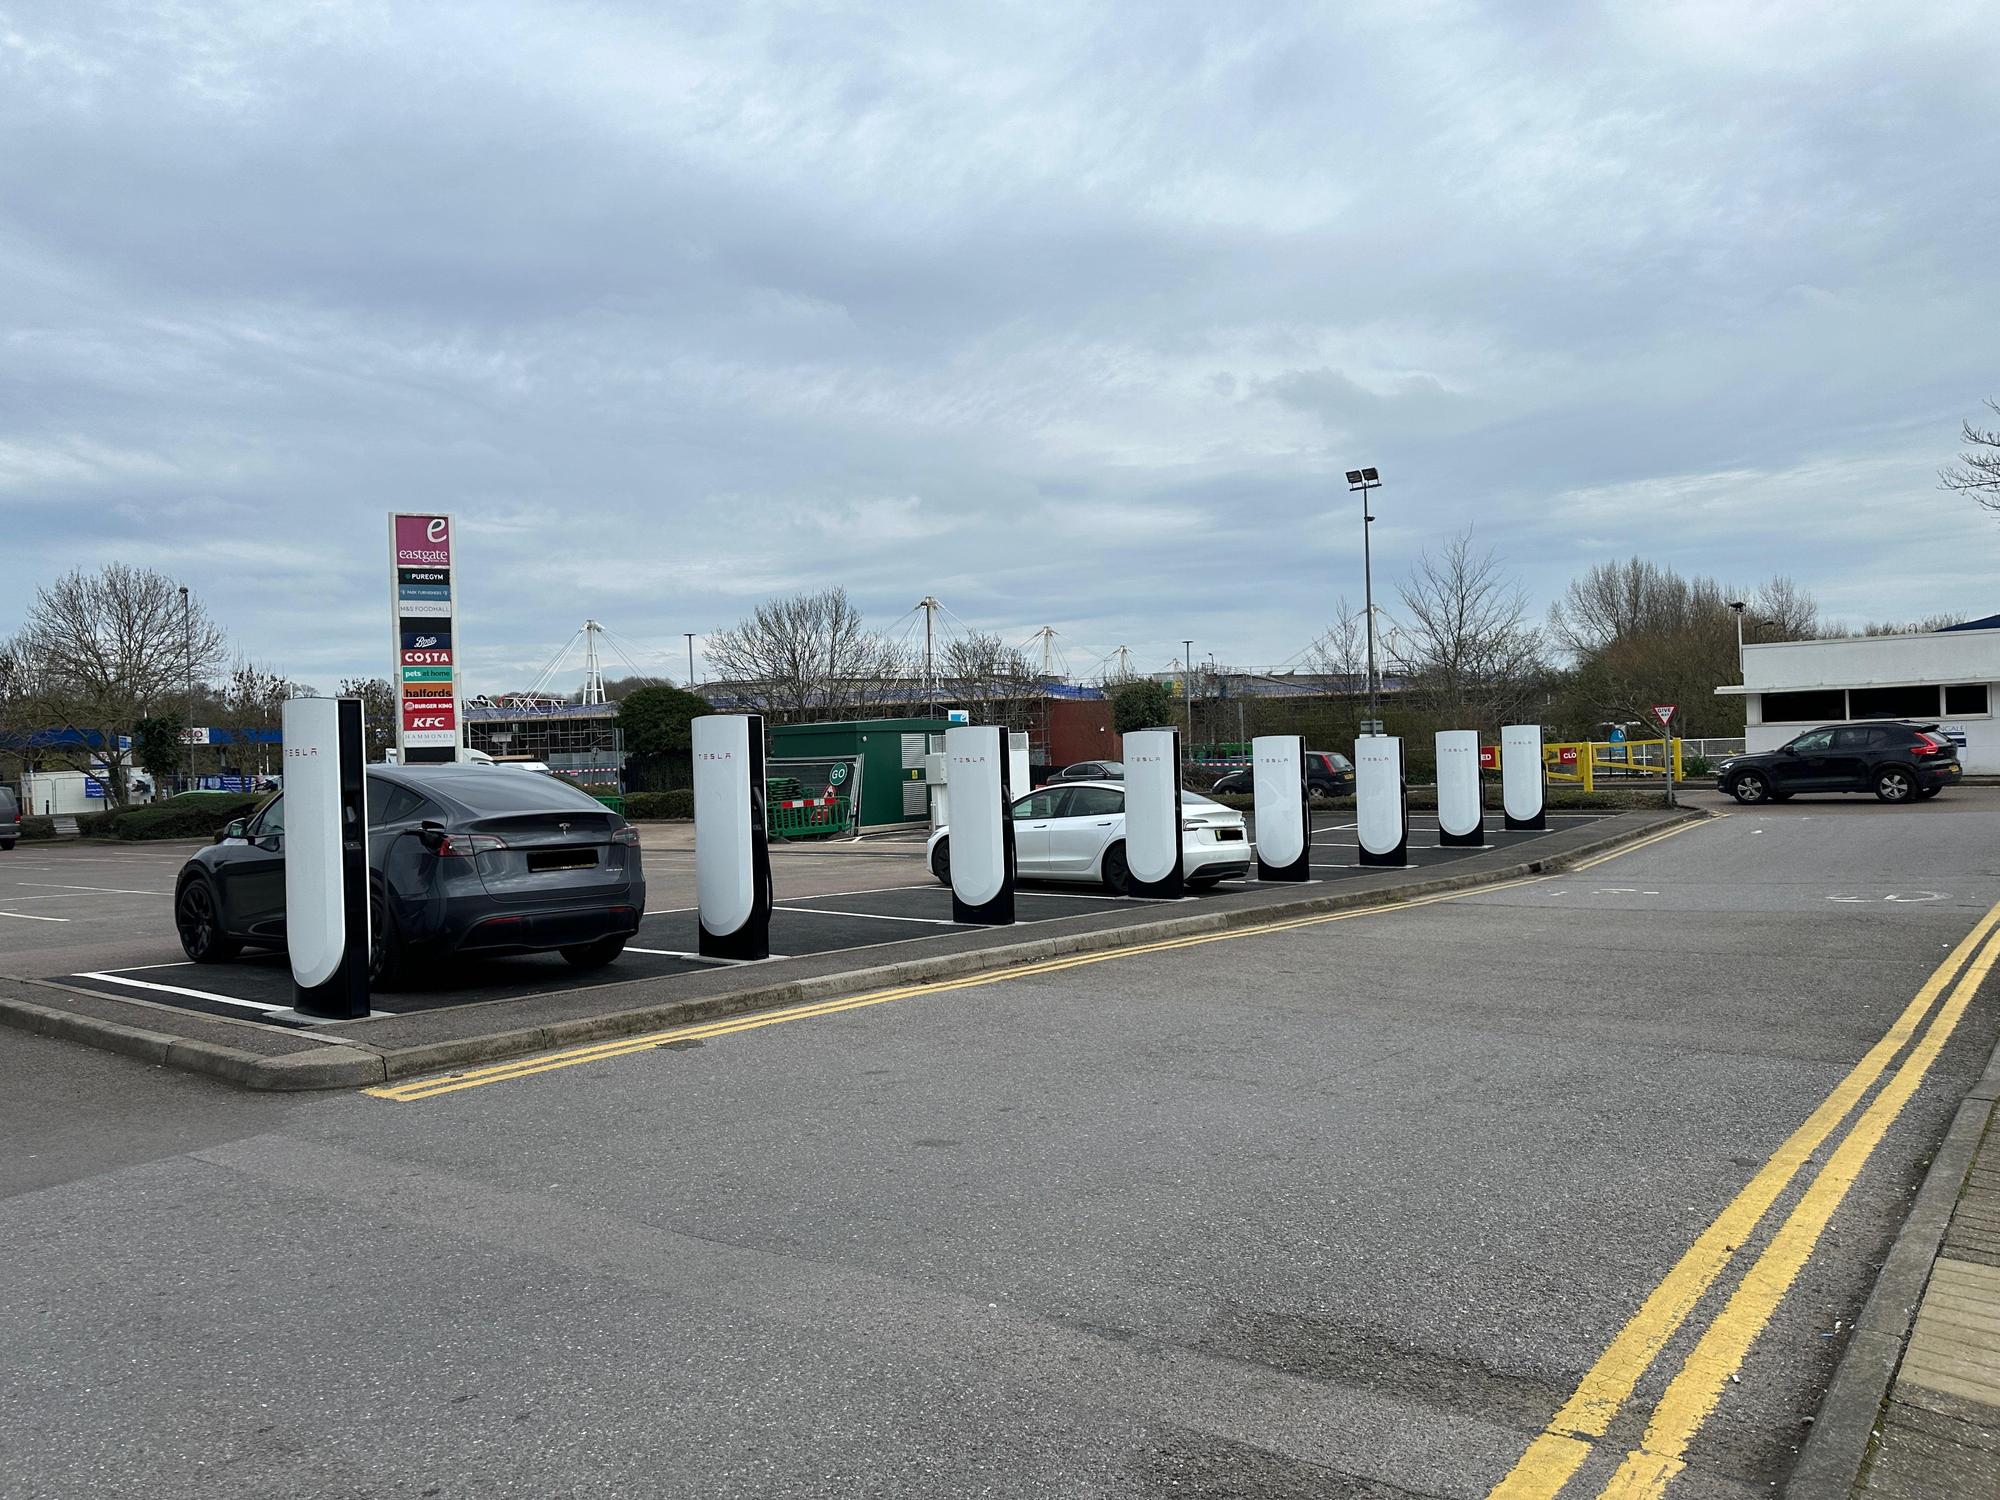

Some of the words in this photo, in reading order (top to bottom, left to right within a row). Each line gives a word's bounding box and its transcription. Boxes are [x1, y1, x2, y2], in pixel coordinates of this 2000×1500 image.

[399, 549, 448, 563] eastgate
[405, 652, 449, 663] COSTA
[405, 669, 421, 678] pets
[422, 669, 430, 677] at
[430, 669, 450, 677] home
[405, 688, 452, 698] halfords
[412, 717, 445, 728] KFC
[284, 747, 318, 757] TESLA
[698, 752, 731, 760] TESLA
[832, 768, 846, 779] GO
